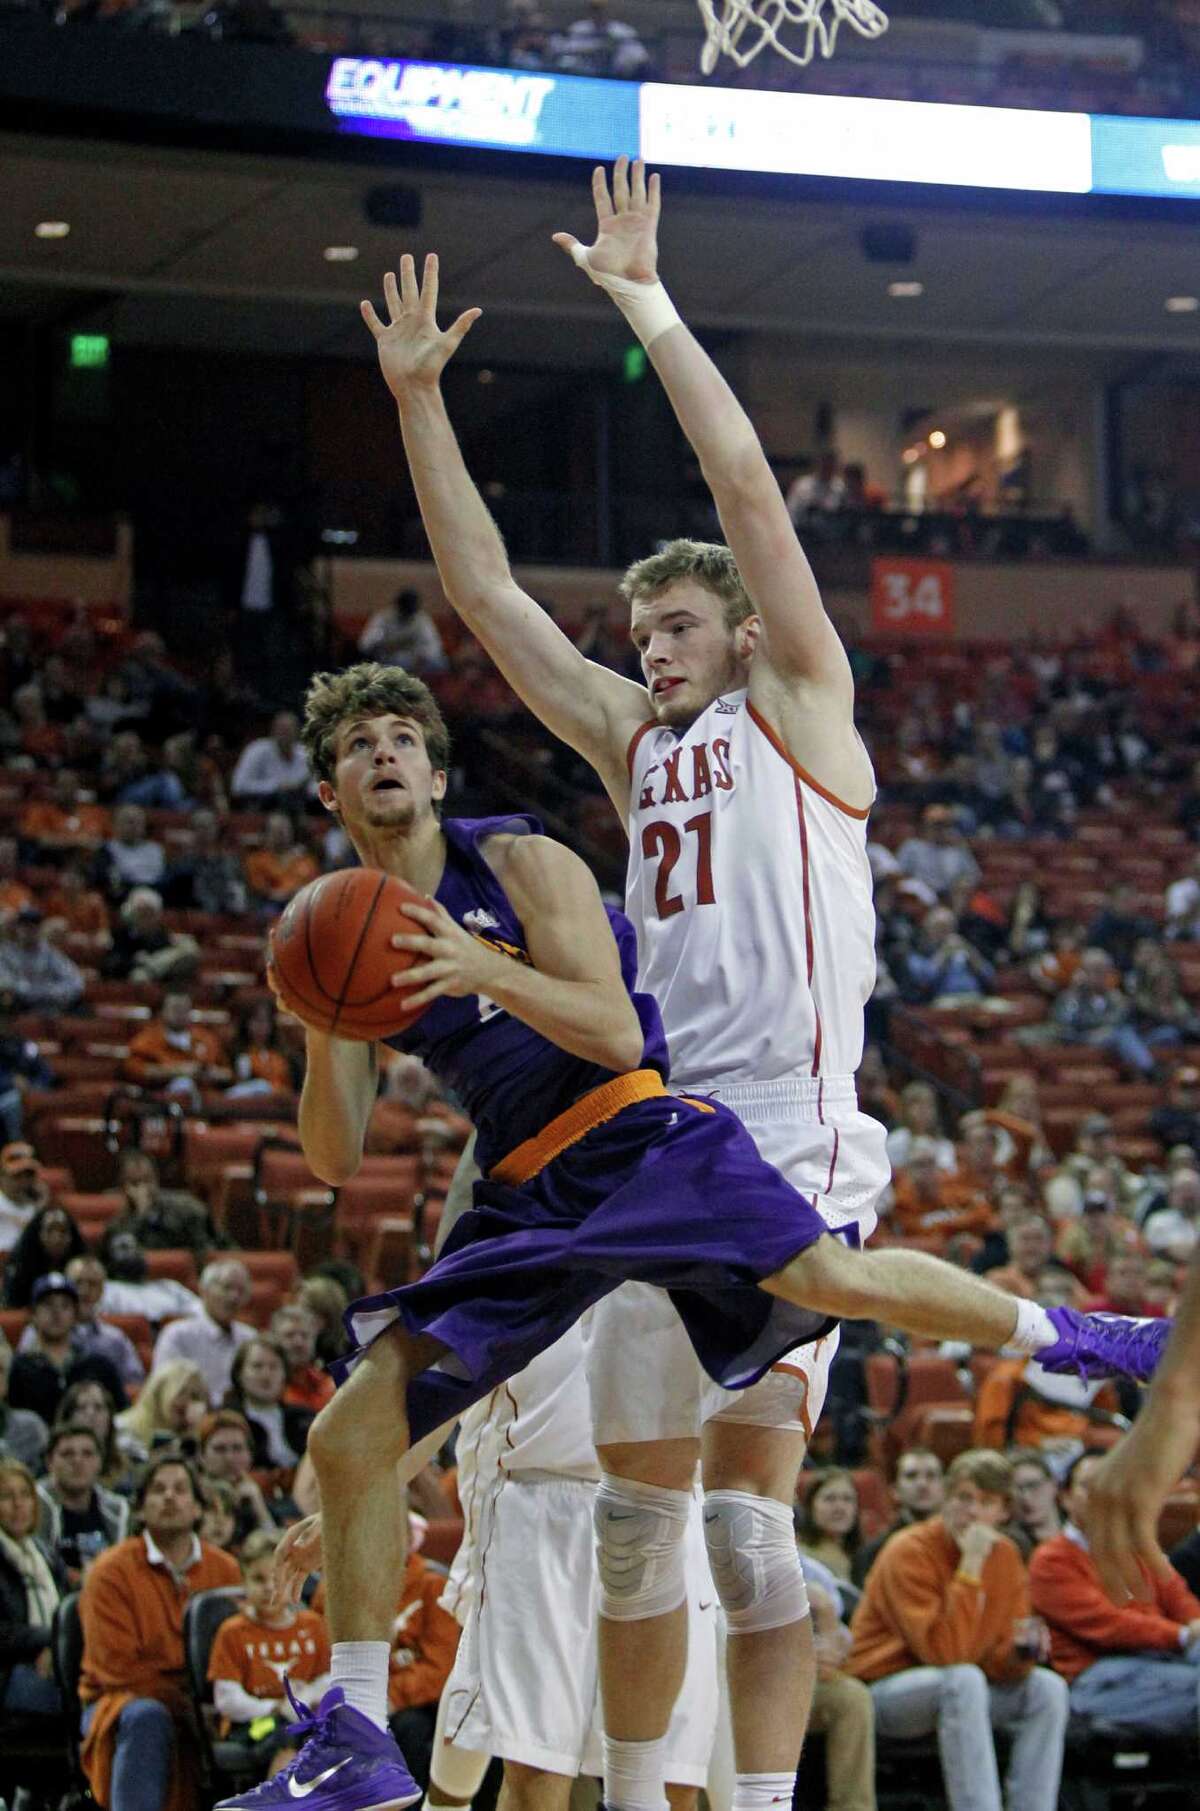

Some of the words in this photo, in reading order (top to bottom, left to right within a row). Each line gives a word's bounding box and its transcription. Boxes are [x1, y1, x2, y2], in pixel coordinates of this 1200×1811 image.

[883, 573, 943, 618] 34
[639, 738, 733, 810] EXAS
[641, 811, 717, 921] 21
